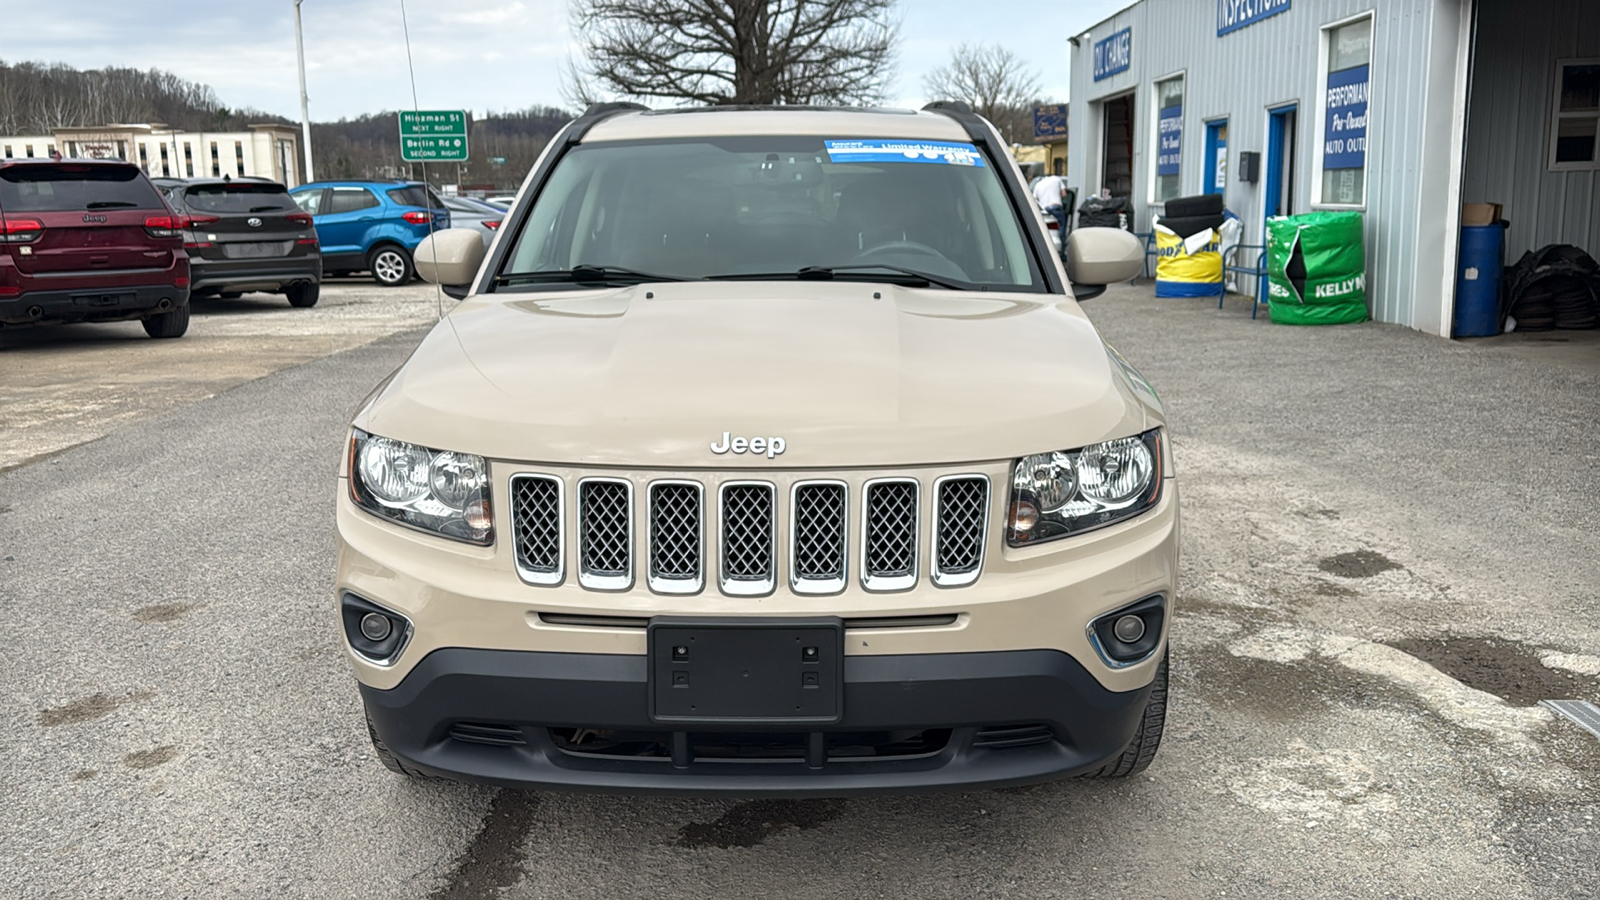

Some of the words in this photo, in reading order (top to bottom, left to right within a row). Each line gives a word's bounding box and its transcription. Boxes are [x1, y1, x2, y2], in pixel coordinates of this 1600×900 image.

[1095, 44, 1103, 76] OIL
[1104, 32, 1129, 72] CHANGE
[449, 113, 460, 122] St
[407, 139, 435, 148] Berlin
[438, 139, 451, 147] Rd
[921, 144, 970, 153] Warranty
[1325, 139, 1344, 155] AUTO
[82, 213, 107, 223] Jeep
[710, 431, 787, 460] Jeep
